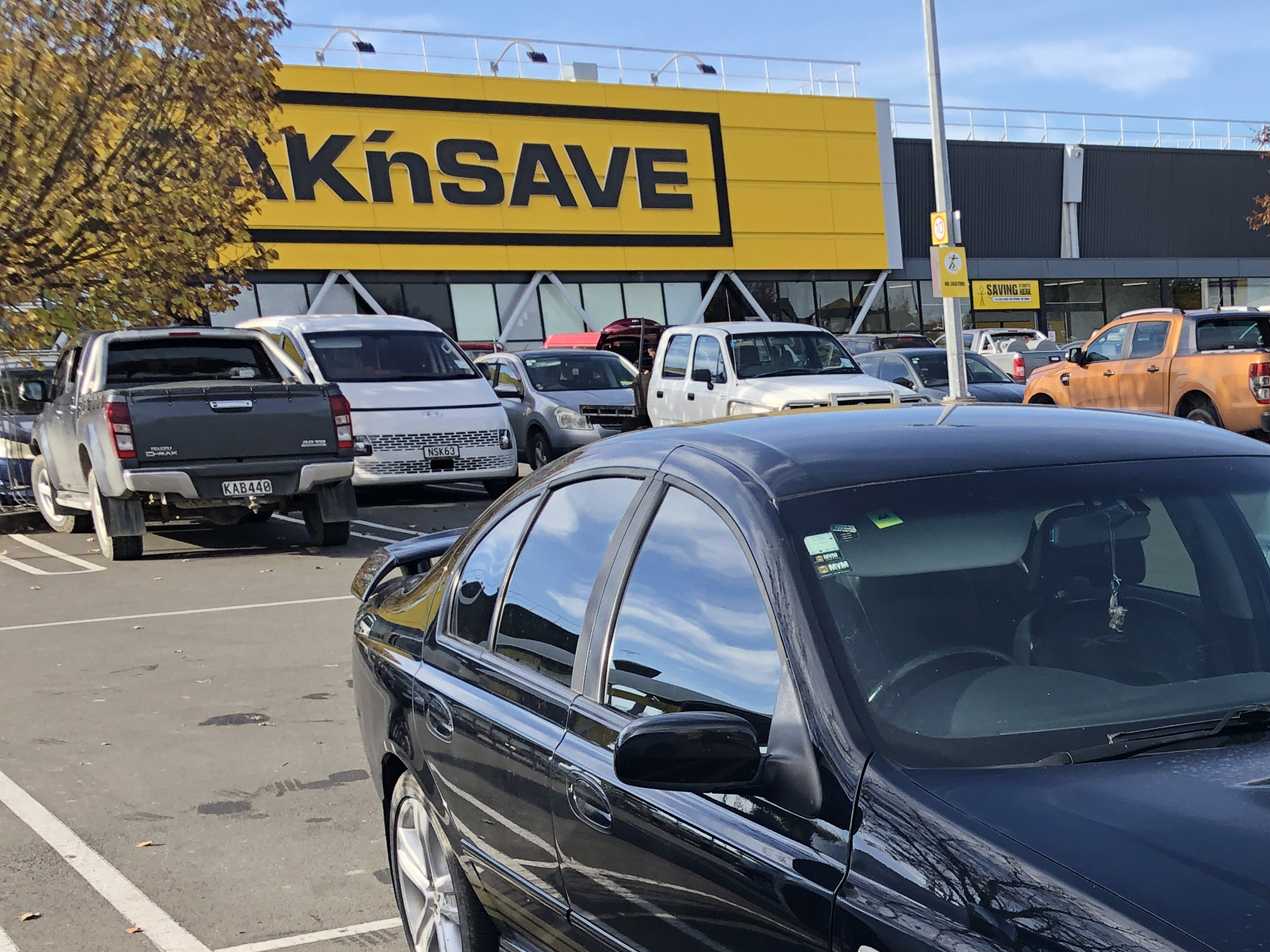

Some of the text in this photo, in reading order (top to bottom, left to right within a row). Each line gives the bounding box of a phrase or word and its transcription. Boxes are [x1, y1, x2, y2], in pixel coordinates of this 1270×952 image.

[936, 221, 943, 234] 10
[986, 284, 1018, 296] SAVING
[428, 447, 456, 456] NSK63
[223, 480, 271, 494] KAB440
